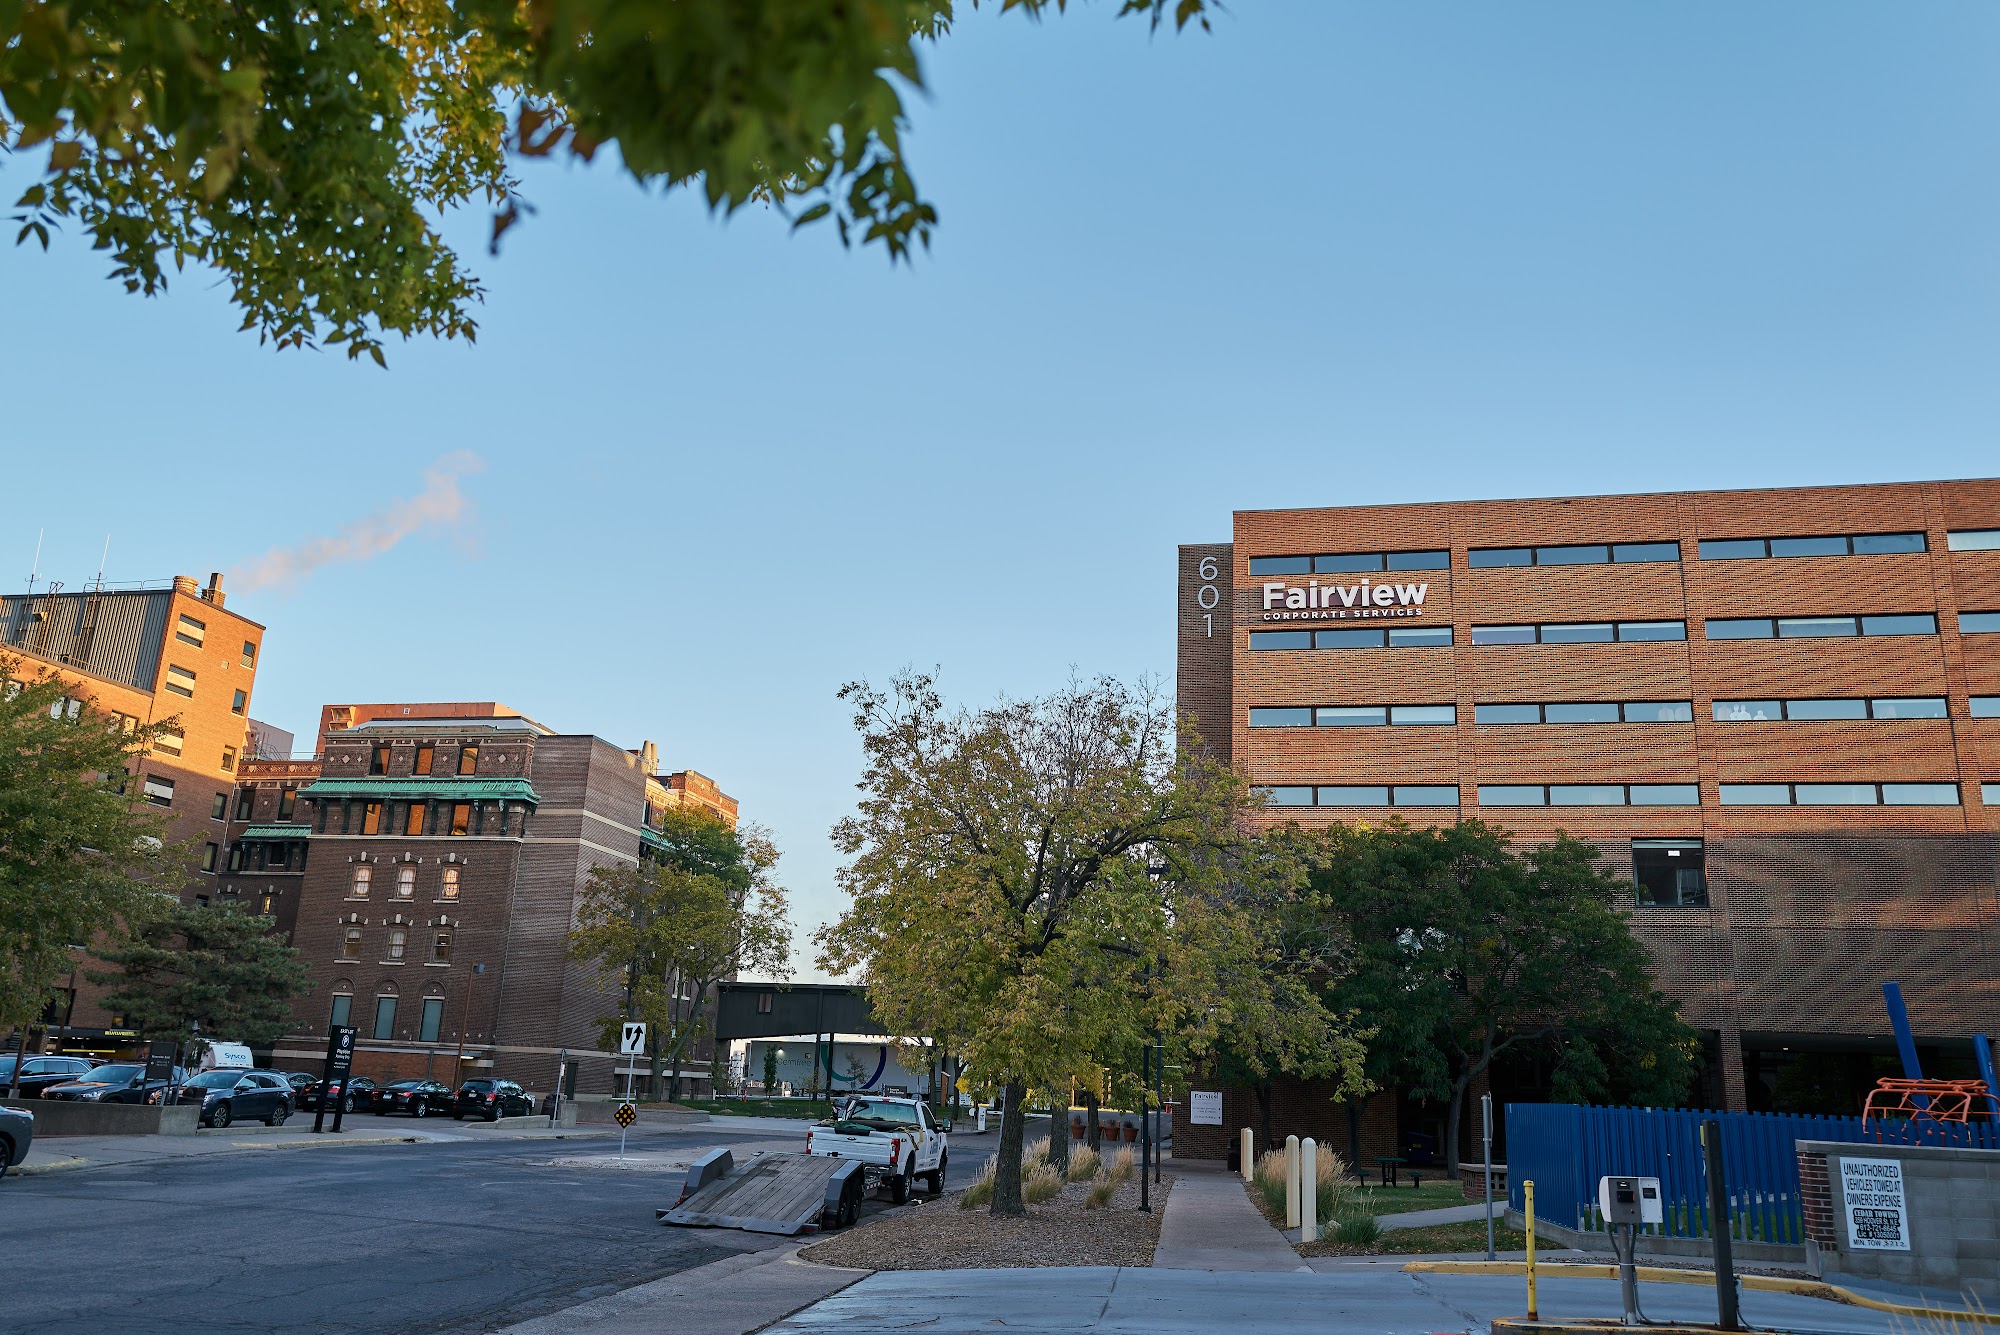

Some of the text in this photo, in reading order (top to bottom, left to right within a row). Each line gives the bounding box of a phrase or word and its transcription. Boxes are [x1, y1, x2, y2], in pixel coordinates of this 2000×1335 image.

[1198, 556, 1220, 638] 601
[1263, 579, 1429, 610] Fairview
[1263, 607, 1423, 621] CORPORATE SERVICES
[224, 1052, 247, 1060] Sysco
[1843, 1163, 1899, 1178] UNAUTHORIZED
[1845, 1178, 1901, 1193] VEHICLES TOWED AT
[1846, 1192, 1902, 1208] OWNERS EXPENSE
[1854, 1209, 1898, 1219] CEDAR TOWING
[1867, 1239, 1881, 1247] TOW
